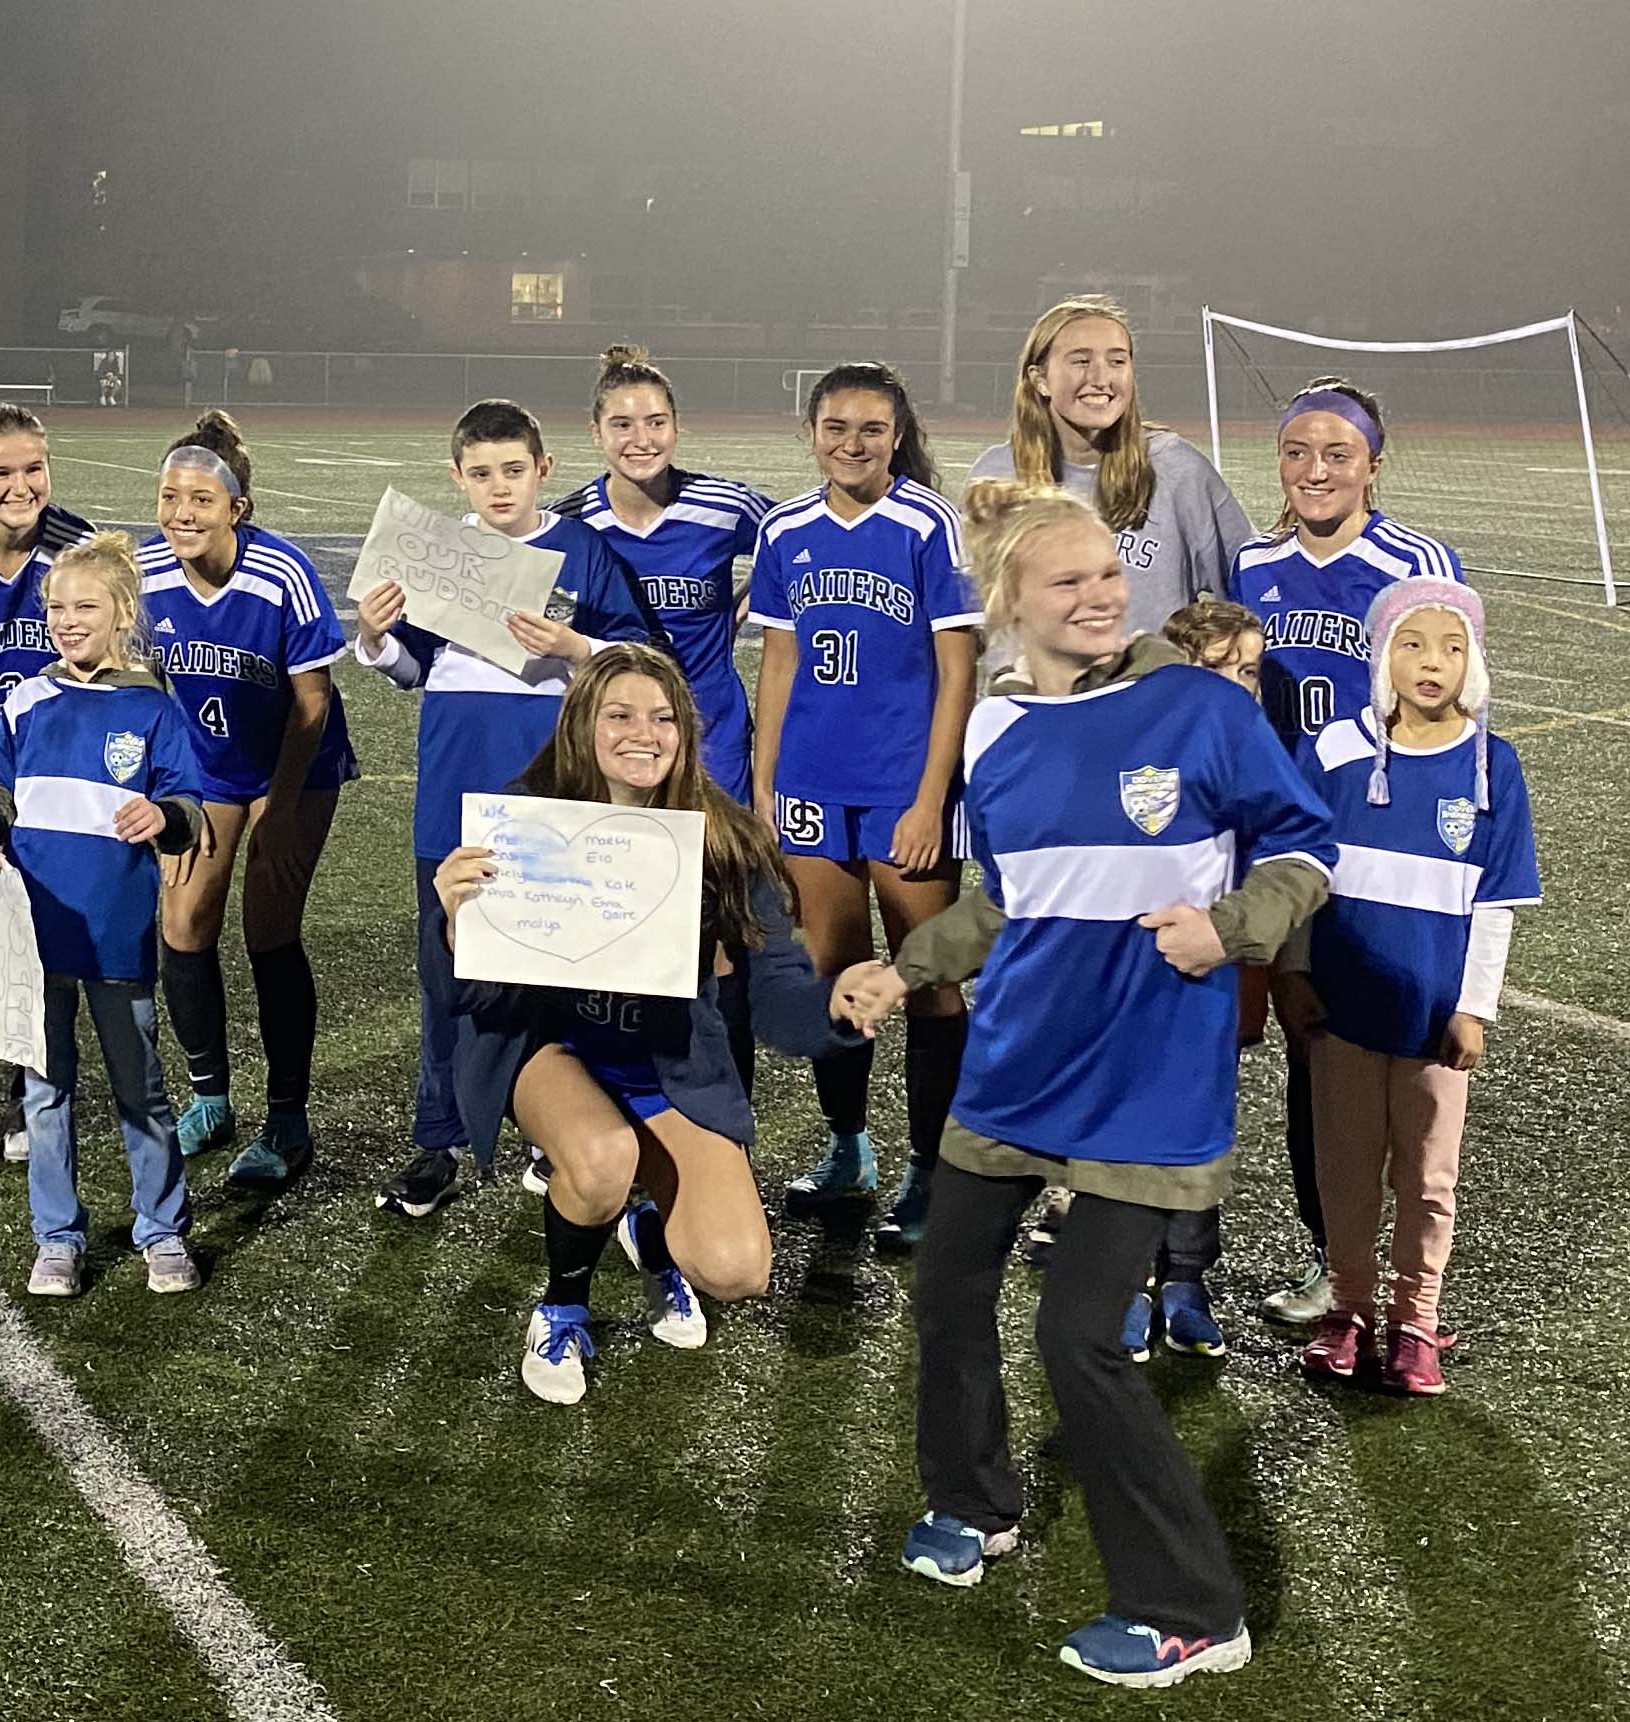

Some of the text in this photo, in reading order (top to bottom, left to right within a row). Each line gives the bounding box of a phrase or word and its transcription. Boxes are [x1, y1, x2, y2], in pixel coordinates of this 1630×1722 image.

[397, 533, 486, 585] OUR
[377, 555, 519, 626] BUDDIE
[787, 568, 915, 626] RAIDERS
[812, 629, 859, 686] 31
[198, 696, 230, 738] 4
